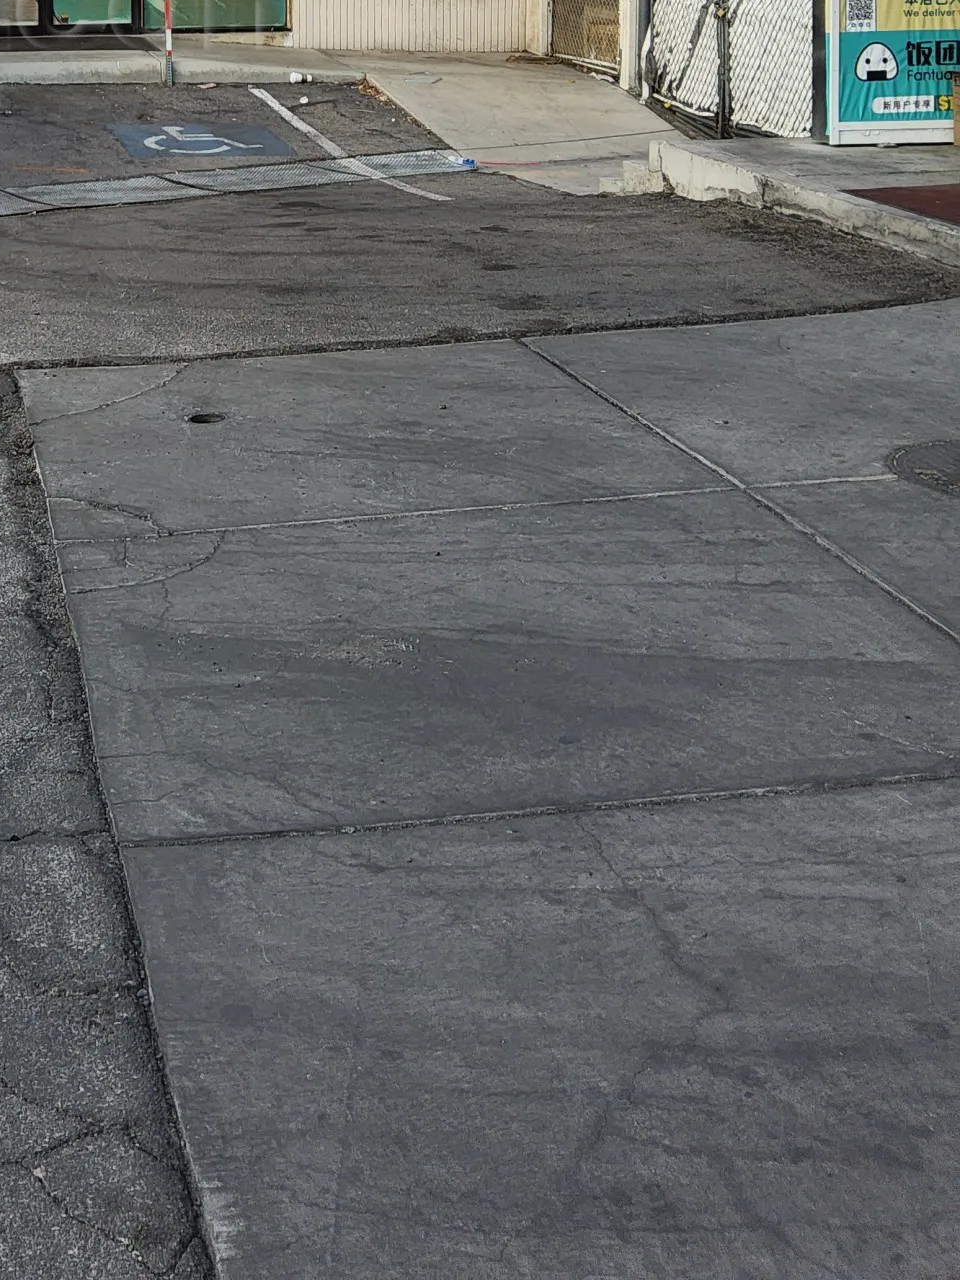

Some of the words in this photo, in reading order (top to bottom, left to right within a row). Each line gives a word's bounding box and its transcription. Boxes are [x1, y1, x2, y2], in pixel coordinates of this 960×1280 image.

[903, 9, 919, 17] We
[922, 8, 956, 17] deliver
[907, 70, 952, 82] Fantua
[882, 99, 932, 111] 新用户专享
